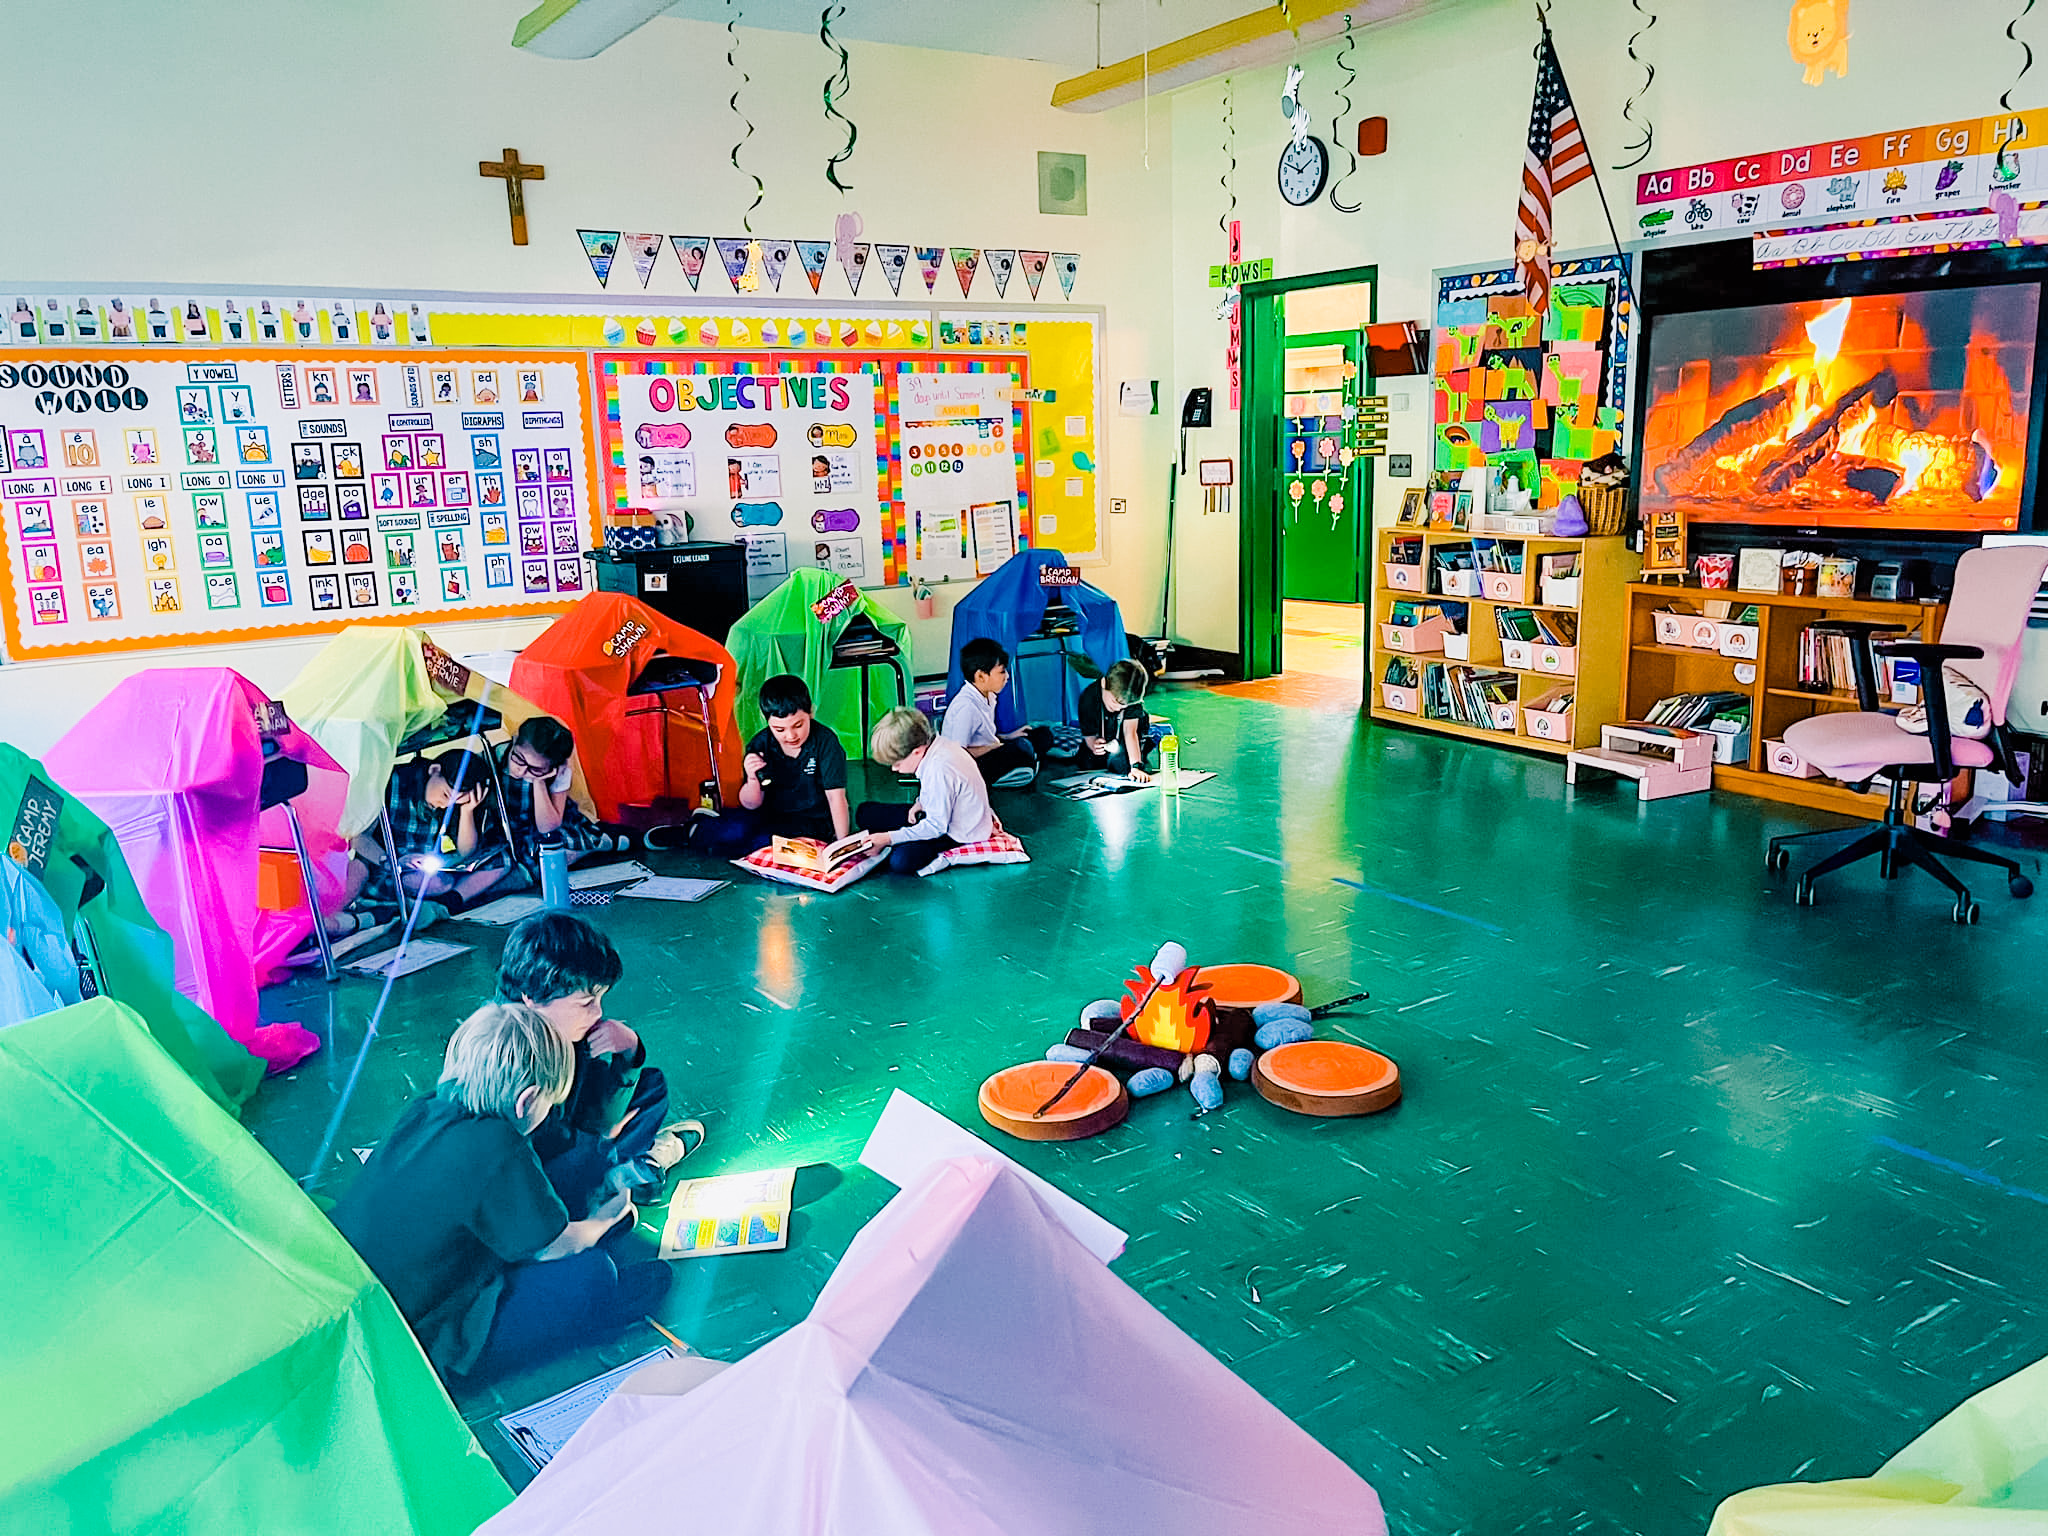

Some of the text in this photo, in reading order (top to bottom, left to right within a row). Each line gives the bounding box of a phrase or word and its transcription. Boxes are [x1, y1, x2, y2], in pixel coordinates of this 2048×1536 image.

[1993, 117, 2028, 144] Hh
[1936, 128, 1970, 154] Gg
[1883, 134, 1912, 160] Ff
[1830, 144, 1860, 168] Ee
[1780, 149, 1811, 176] Dd
[1734, 160, 1761, 182] Cc
[1688, 167, 1715, 190] Bb
[1645, 175, 1672, 196] Aa
[0, 364, 129, 388] SOUND
[193, 368, 235, 379] Y VOWEL
[312, 371, 329, 382] kn
[353, 373, 370, 382] wr
[437, 371, 451, 382] ed
[478, 371, 492, 382] ed
[523, 371, 537, 382] ed
[280, 372, 296, 406] LETTERS
[649, 376, 850, 412] OBJECTIVES
[1025, 390, 1043, 399] MAY
[35, 387, 148, 415] WALL
[464, 416, 502, 427] DIGRAPHS
[308, 423, 344, 434] SOUNDS
[390, 439, 404, 448] or
[422, 438, 437, 447] ar
[478, 436, 492, 447] sh
[519, 453, 533, 463] oy
[127, 477, 166, 489] LONG I
[186, 475, 225, 487] LONG O
[242, 474, 279, 485] LONG U
[413, 476, 428, 485] ur
[448, 476, 461, 484] er
[483, 474, 497, 485] th
[8, 482, 50, 495] LONG A
[66, 480, 106, 492] LONG E
[302, 488, 324, 501] dge
[343, 490, 359, 498] oo
[522, 490, 536, 498] oo
[553, 488, 567, 496] ou
[199, 498, 218, 507] ow
[254, 496, 271, 505] ue
[25, 506, 42, 517] ay
[81, 504, 99, 514] ee
[436, 512, 467, 523] SPELLING
[487, 513, 501, 525] ch
[525, 526, 540, 534] ow
[556, 525, 571, 533] ew
[205, 537, 223, 546] oa
[349, 531, 362, 542] all
[87, 546, 104, 555] ea
[491, 556, 505, 568] ph
[528, 563, 542, 572] au
[560, 562, 575, 571] aw
[1047, 568, 1072, 577] CAMP
[1040, 575, 1079, 584] BRENDAN
[611, 620, 635, 647] CAMP
[615, 623, 647, 658] SHAWN
[16, 798, 40, 848] CAMP
[28, 800, 58, 868] JEREMY
